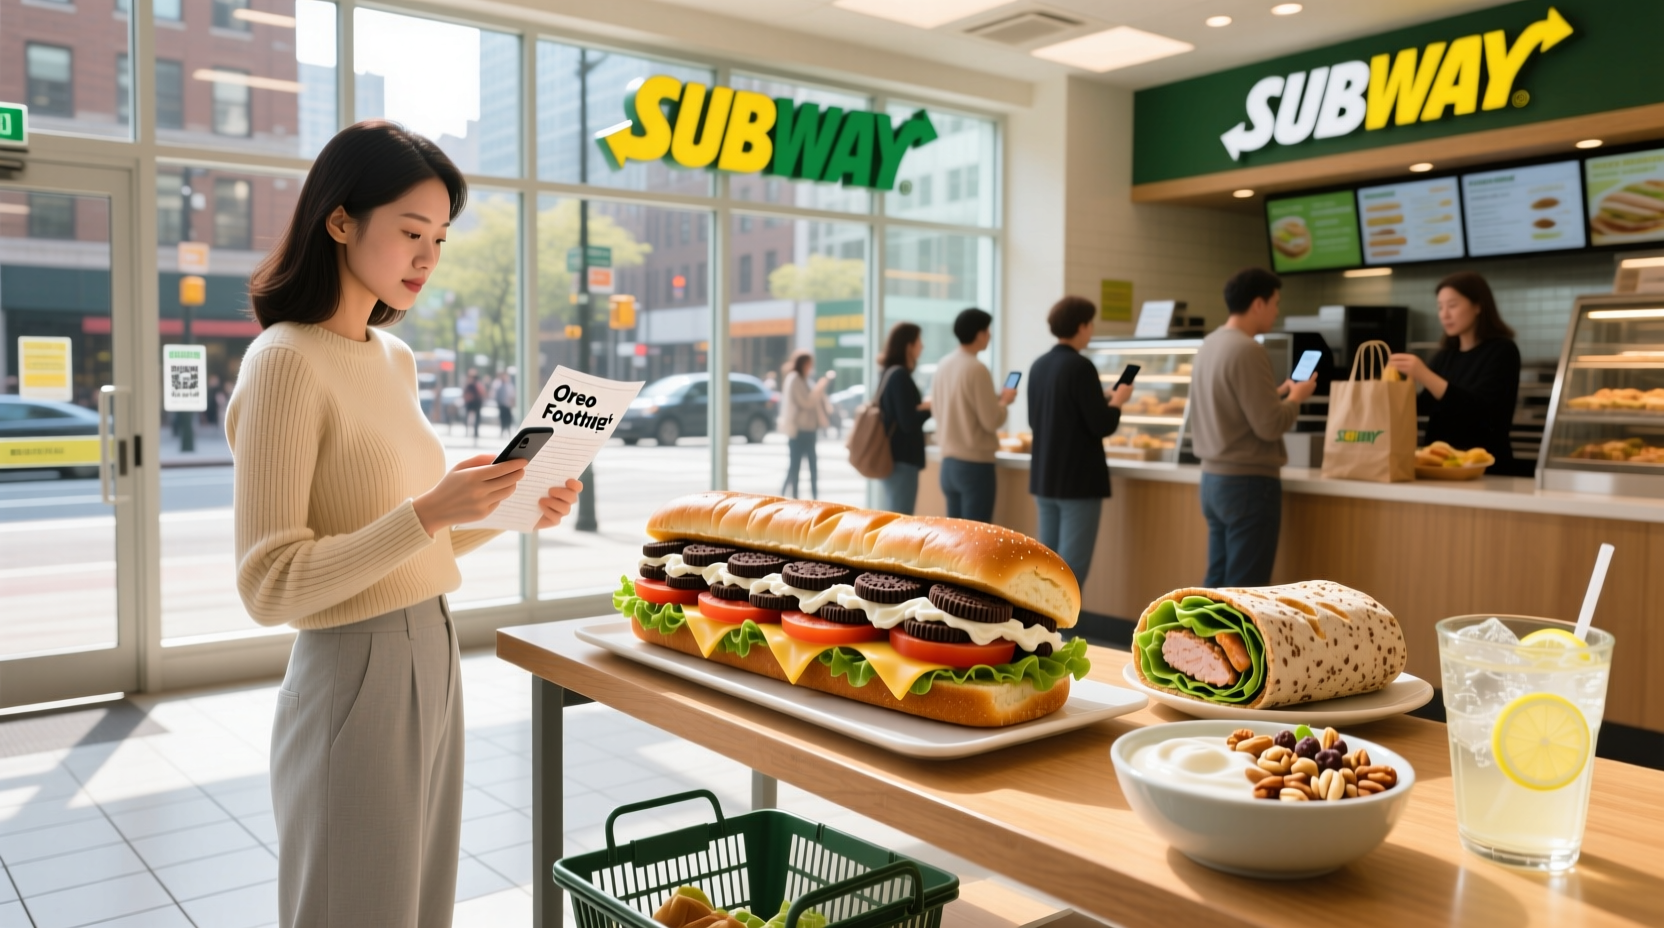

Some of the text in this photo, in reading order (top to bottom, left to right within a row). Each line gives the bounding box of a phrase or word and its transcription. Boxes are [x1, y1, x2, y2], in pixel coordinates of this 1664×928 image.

[595, 74, 938, 191] SUBWAY
[1220, 7, 1574, 162] SUBWAY
[553, 384, 597, 408] Oreo
